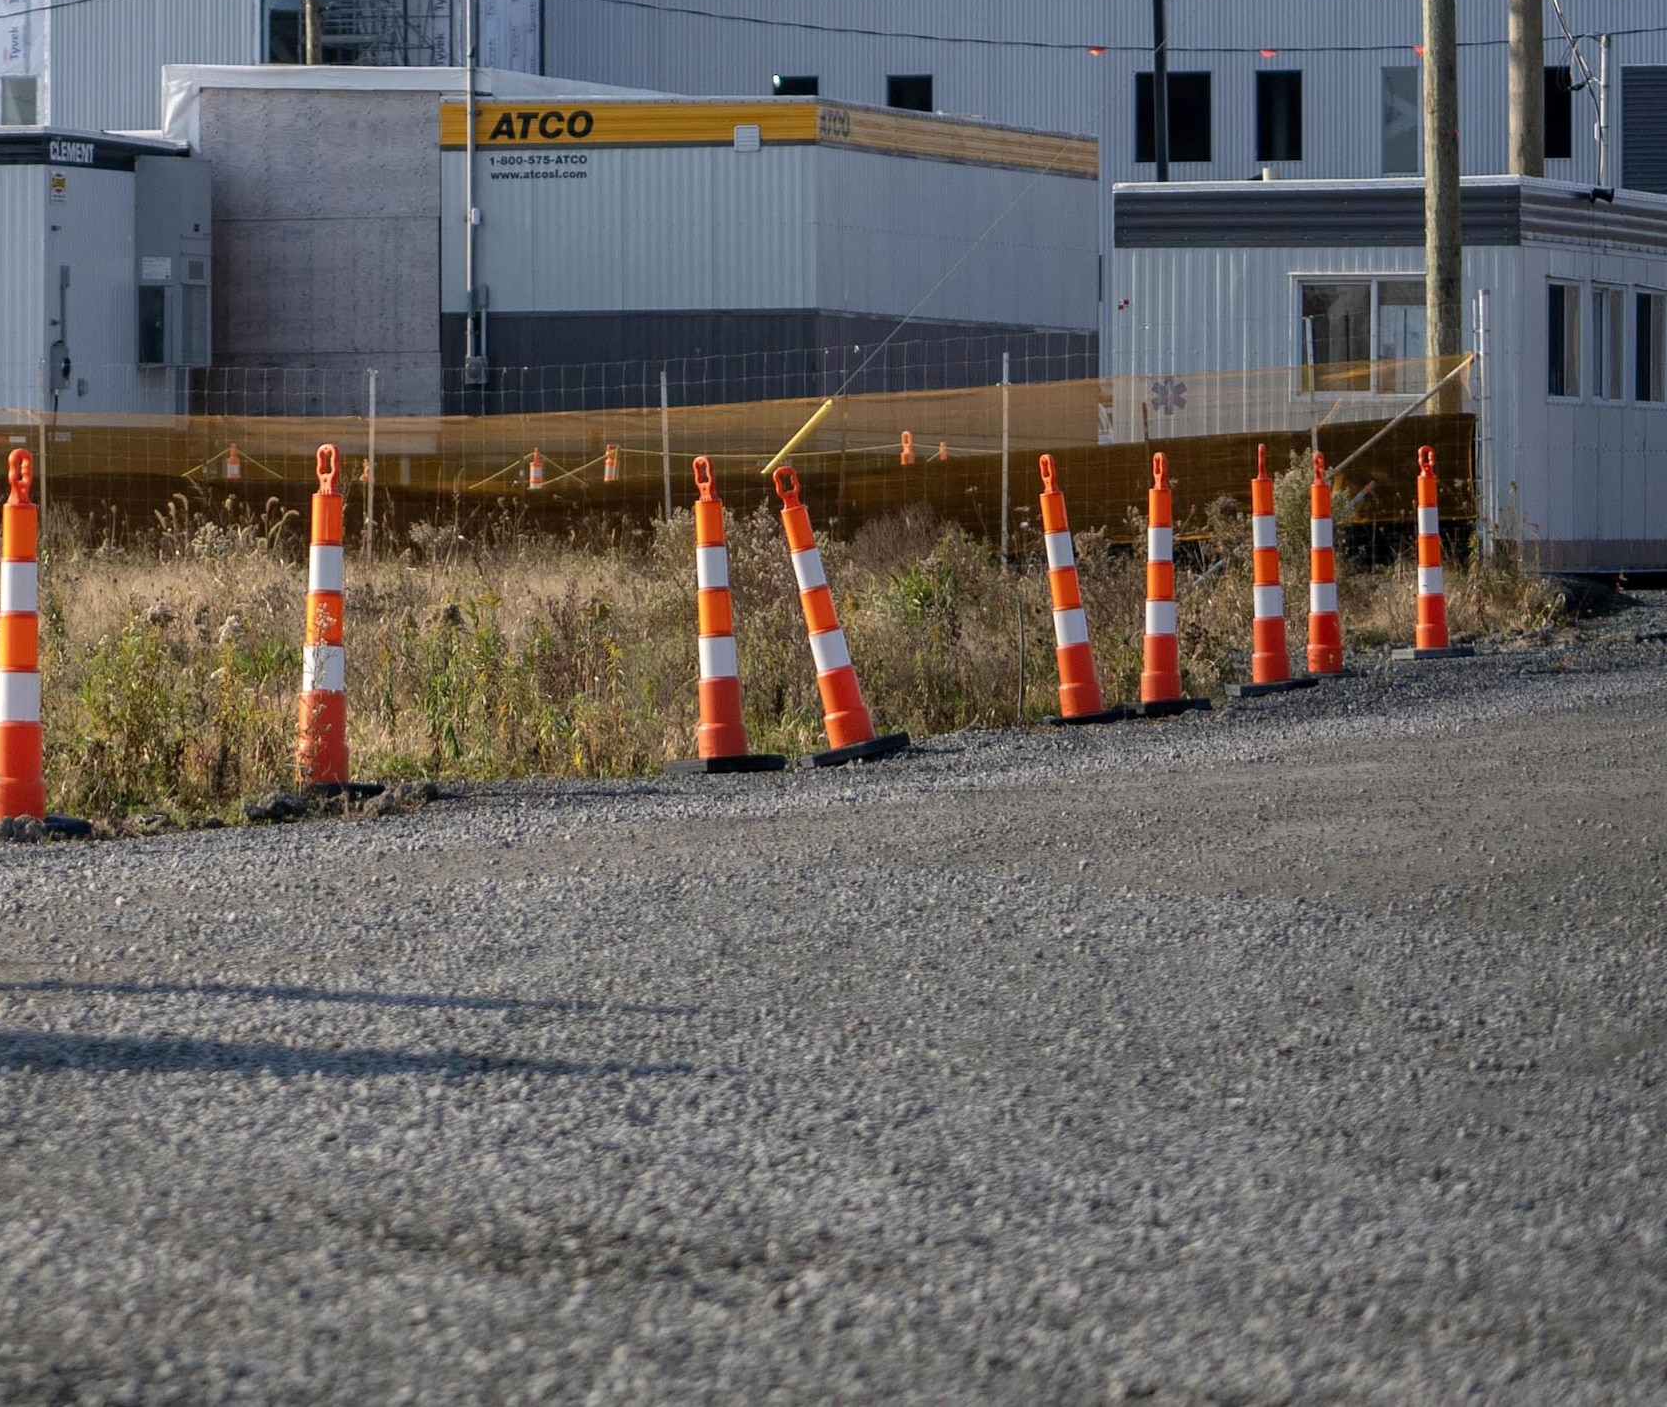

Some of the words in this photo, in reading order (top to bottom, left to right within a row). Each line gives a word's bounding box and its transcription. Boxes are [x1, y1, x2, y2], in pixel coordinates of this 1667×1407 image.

[9, 27, 20, 59] Tyvek
[435, 33, 446, 65] Tyvek
[489, 110, 594, 140] ATCO
[489, 154, 588, 167] 1-800-575-ATCO
